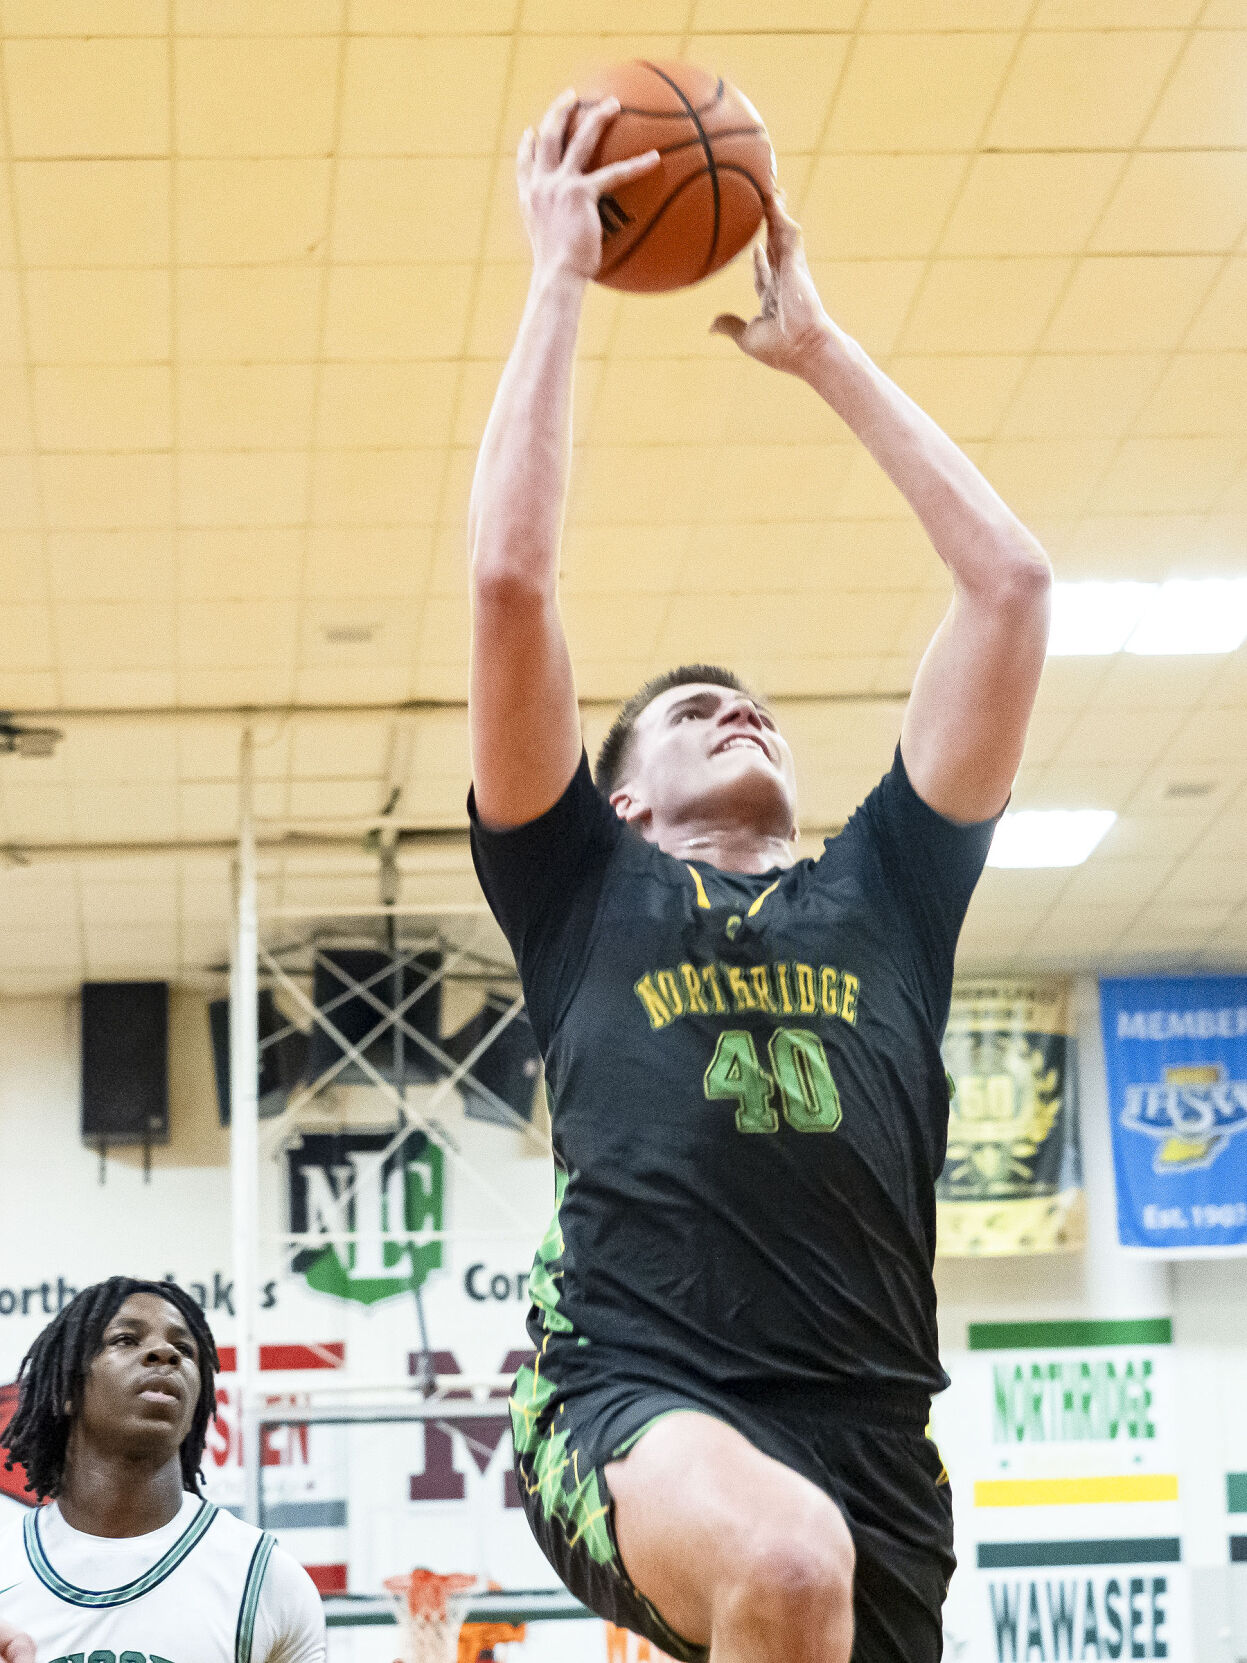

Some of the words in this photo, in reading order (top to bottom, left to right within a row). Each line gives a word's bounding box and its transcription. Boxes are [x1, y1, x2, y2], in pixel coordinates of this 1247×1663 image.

[634, 961, 861, 1031] NORTHRIDGE
[704, 1027, 843, 1134] 40
[987, 1575, 1168, 1663] WAWASEE
